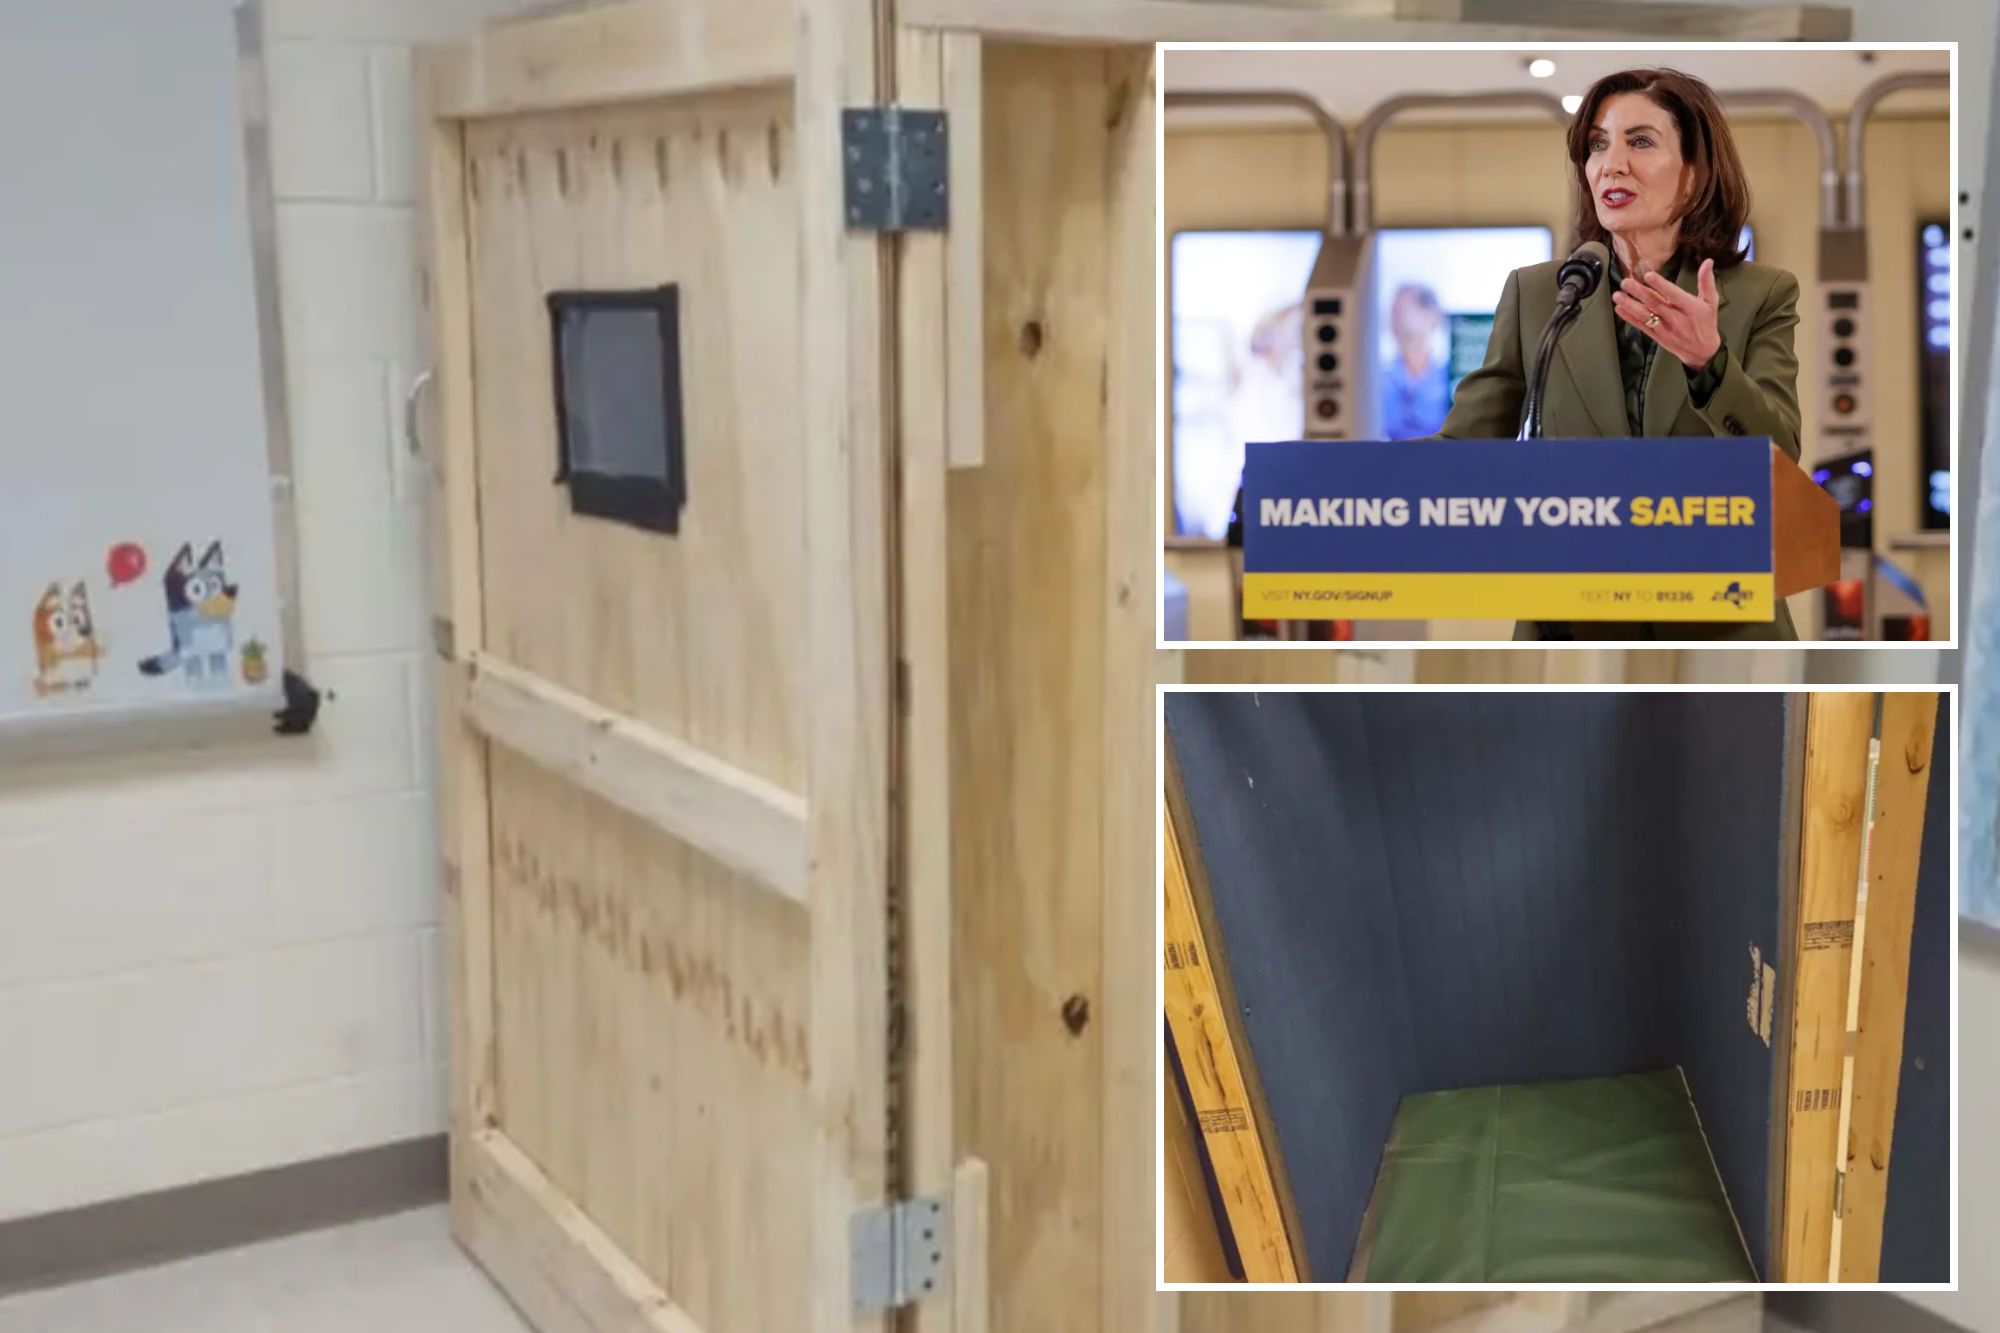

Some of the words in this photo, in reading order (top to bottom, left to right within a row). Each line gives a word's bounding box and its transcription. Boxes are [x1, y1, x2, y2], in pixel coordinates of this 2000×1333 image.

[1260, 498, 1410, 527] MAKING
[1419, 498, 1507, 526] NEW
[1514, 496, 1622, 527] YORK
[1629, 496, 1756, 527] SAFER
[1293, 590, 1393, 601] NY.GOV/SIGNUP
[1613, 590, 1632, 601] NY
